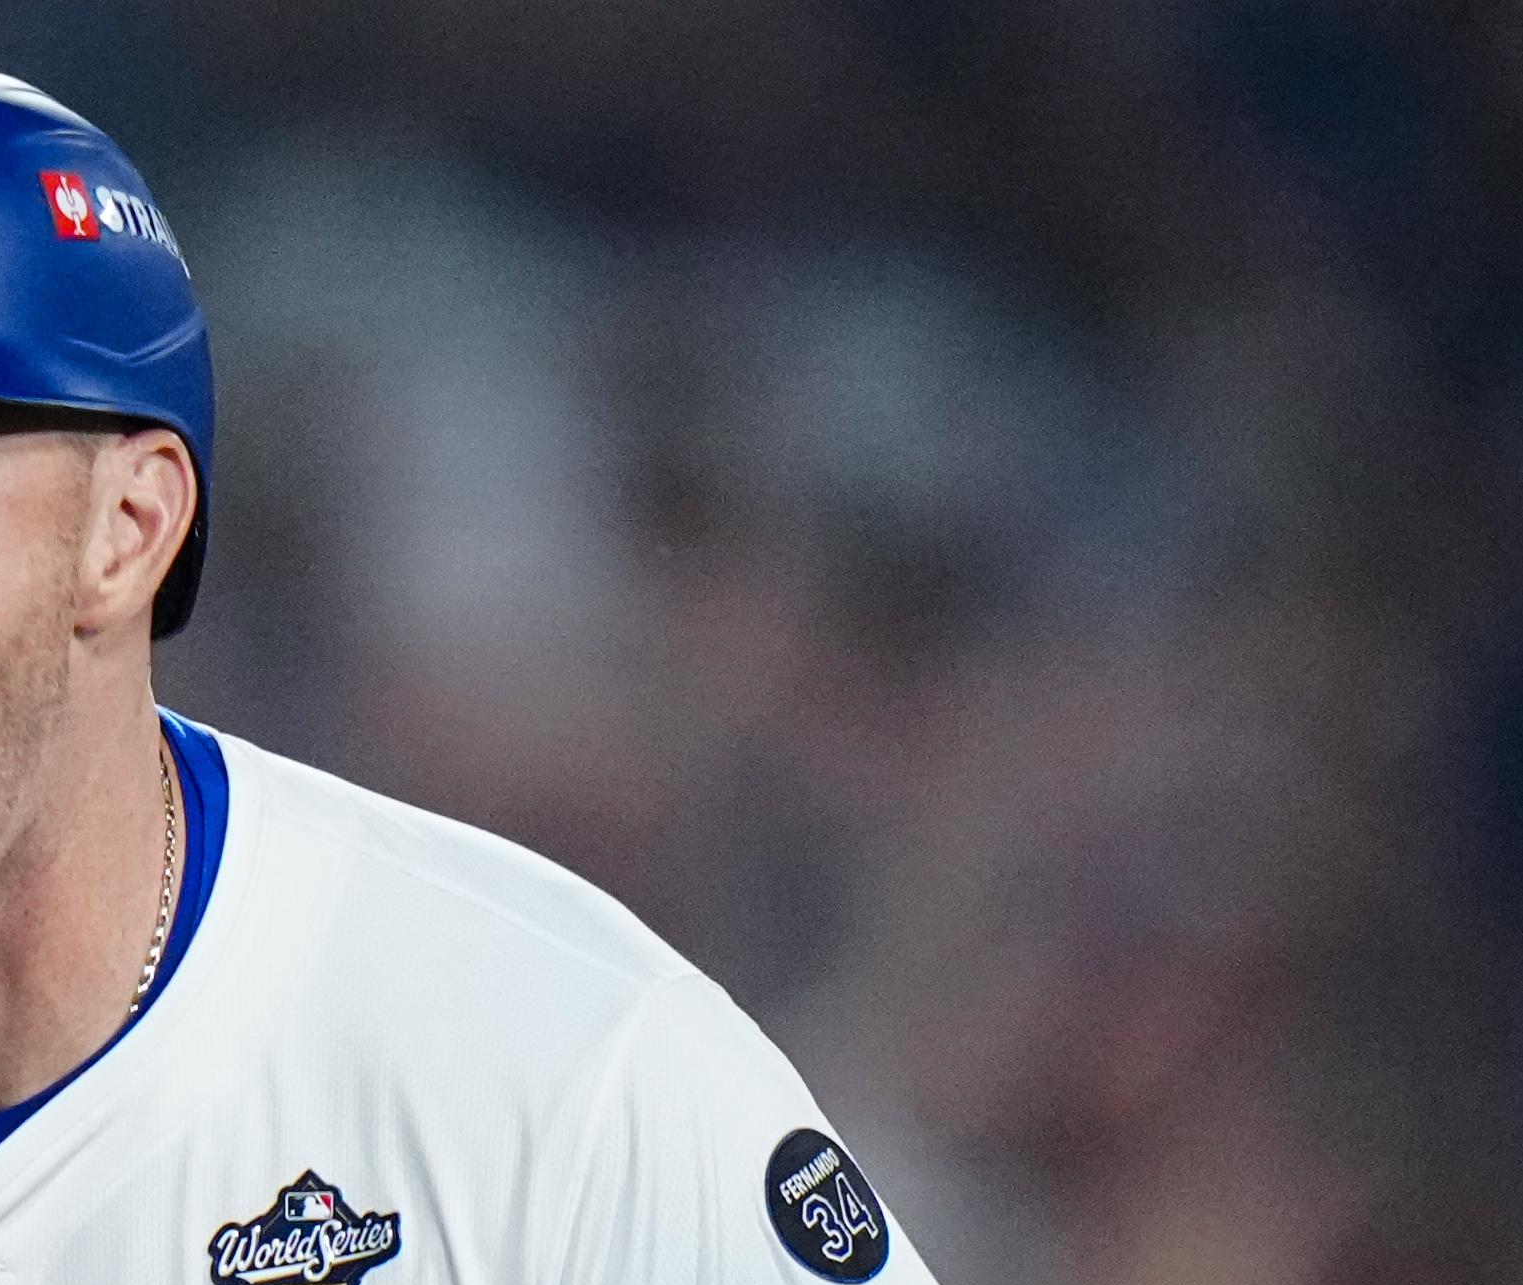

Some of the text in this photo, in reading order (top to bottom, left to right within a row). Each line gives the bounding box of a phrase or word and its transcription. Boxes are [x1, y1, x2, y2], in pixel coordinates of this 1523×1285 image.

[778, 1146, 841, 1206] FERNANDO
[801, 1171, 880, 1264] 34
[216, 1219, 394, 1283] World Series
